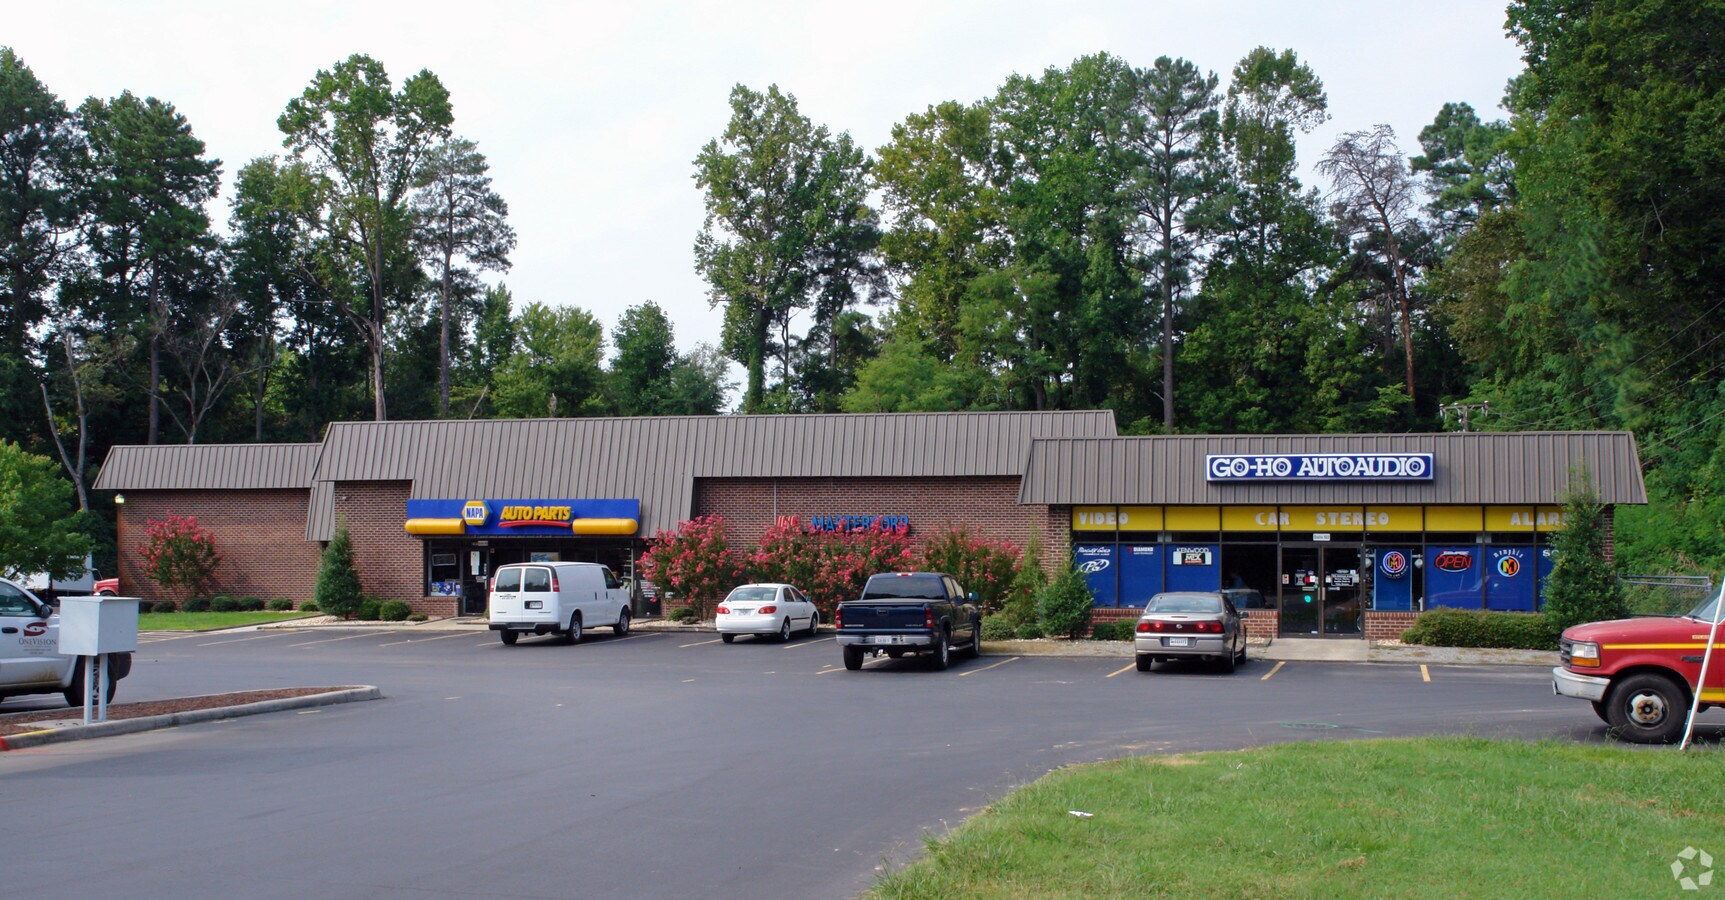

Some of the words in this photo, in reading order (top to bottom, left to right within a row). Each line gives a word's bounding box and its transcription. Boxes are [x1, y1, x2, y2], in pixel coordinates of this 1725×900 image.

[1211, 457, 1292, 477] GO-HO
[1297, 457, 1426, 477] AUTOAUDIO
[466, 506, 484, 518] NAPA
[501, 506, 534, 520] AUTO
[533, 506, 572, 520] PARTS
[1078, 511, 1129, 525] VIDEO
[1255, 512, 1290, 525] CAR
[1315, 512, 1389, 525] STEREO
[1510, 512, 1568, 526] ALAR
[1435, 555, 1473, 569] OPEN
